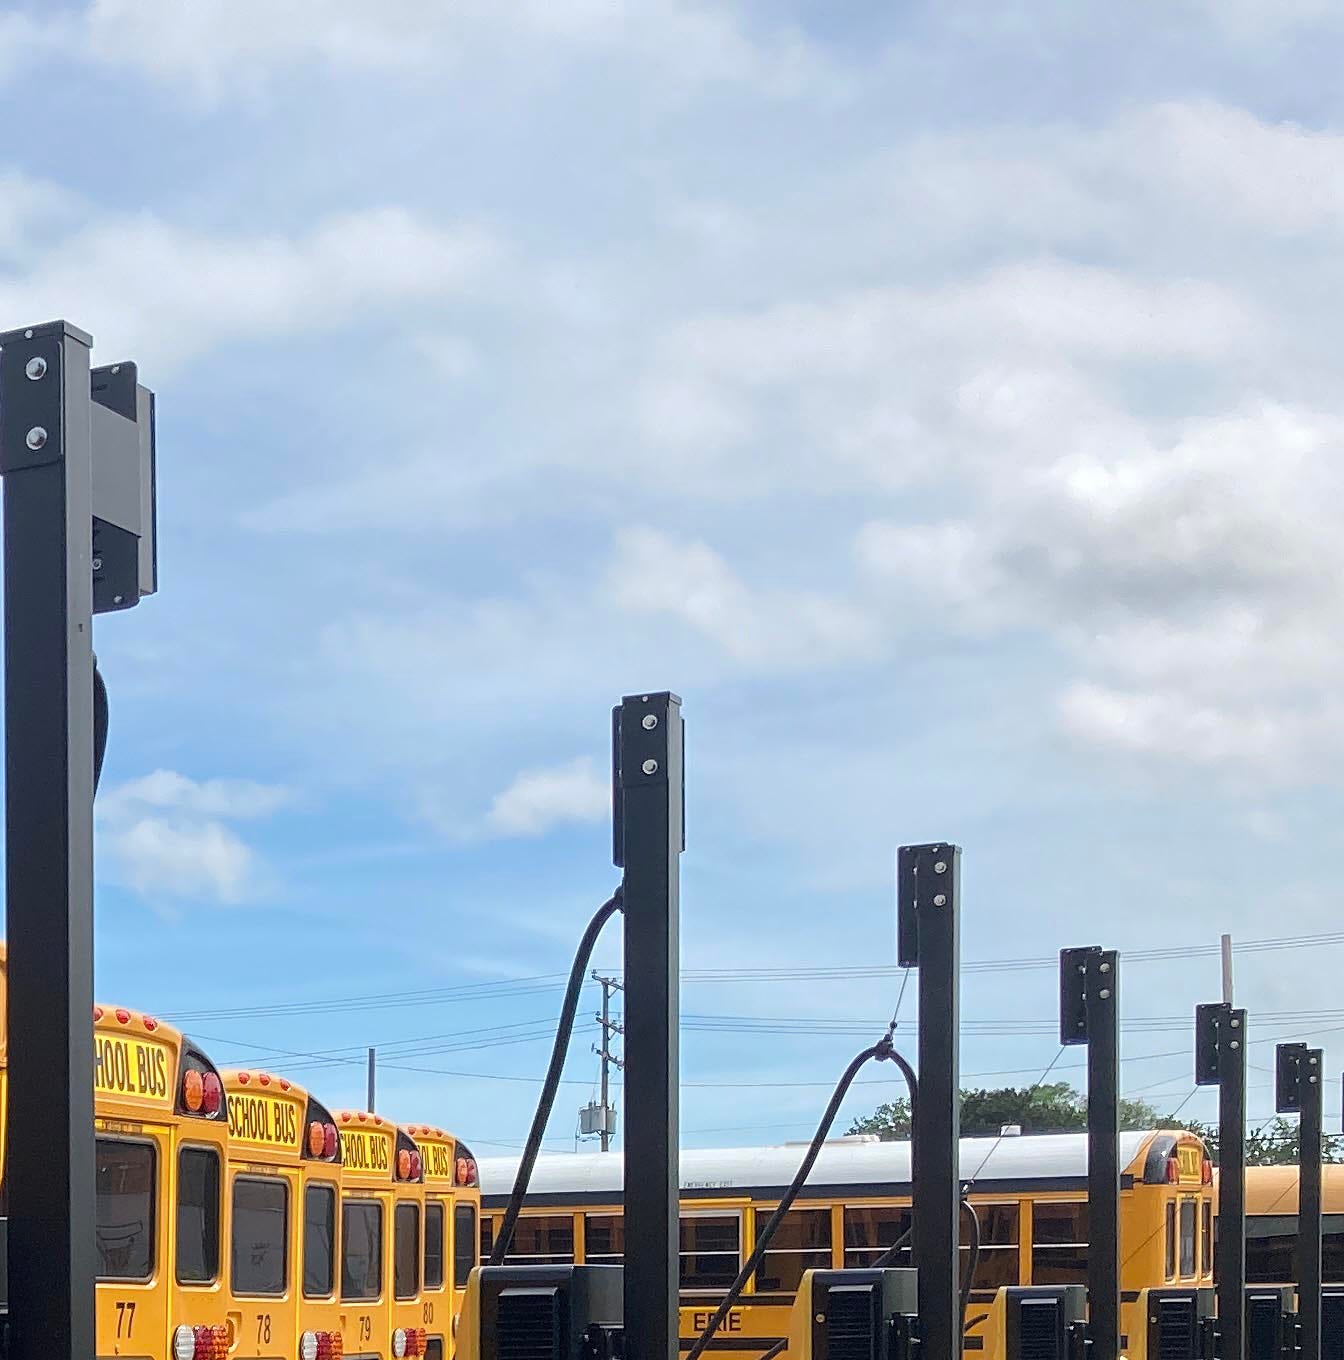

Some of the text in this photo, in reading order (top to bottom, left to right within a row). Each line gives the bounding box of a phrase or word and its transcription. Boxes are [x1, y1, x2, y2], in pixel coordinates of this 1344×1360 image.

[93, 1037, 167, 1098] HOOL BUS
[227, 1095, 296, 1145] SCHOOL BUS
[341, 1132, 388, 1170] HOOL BUS
[432, 1145, 449, 1177] BUS
[115, 1301, 136, 1339] 77
[256, 1313, 271, 1345] 78
[359, 1315, 371, 1342] 79
[423, 1301, 434, 1325] 80
